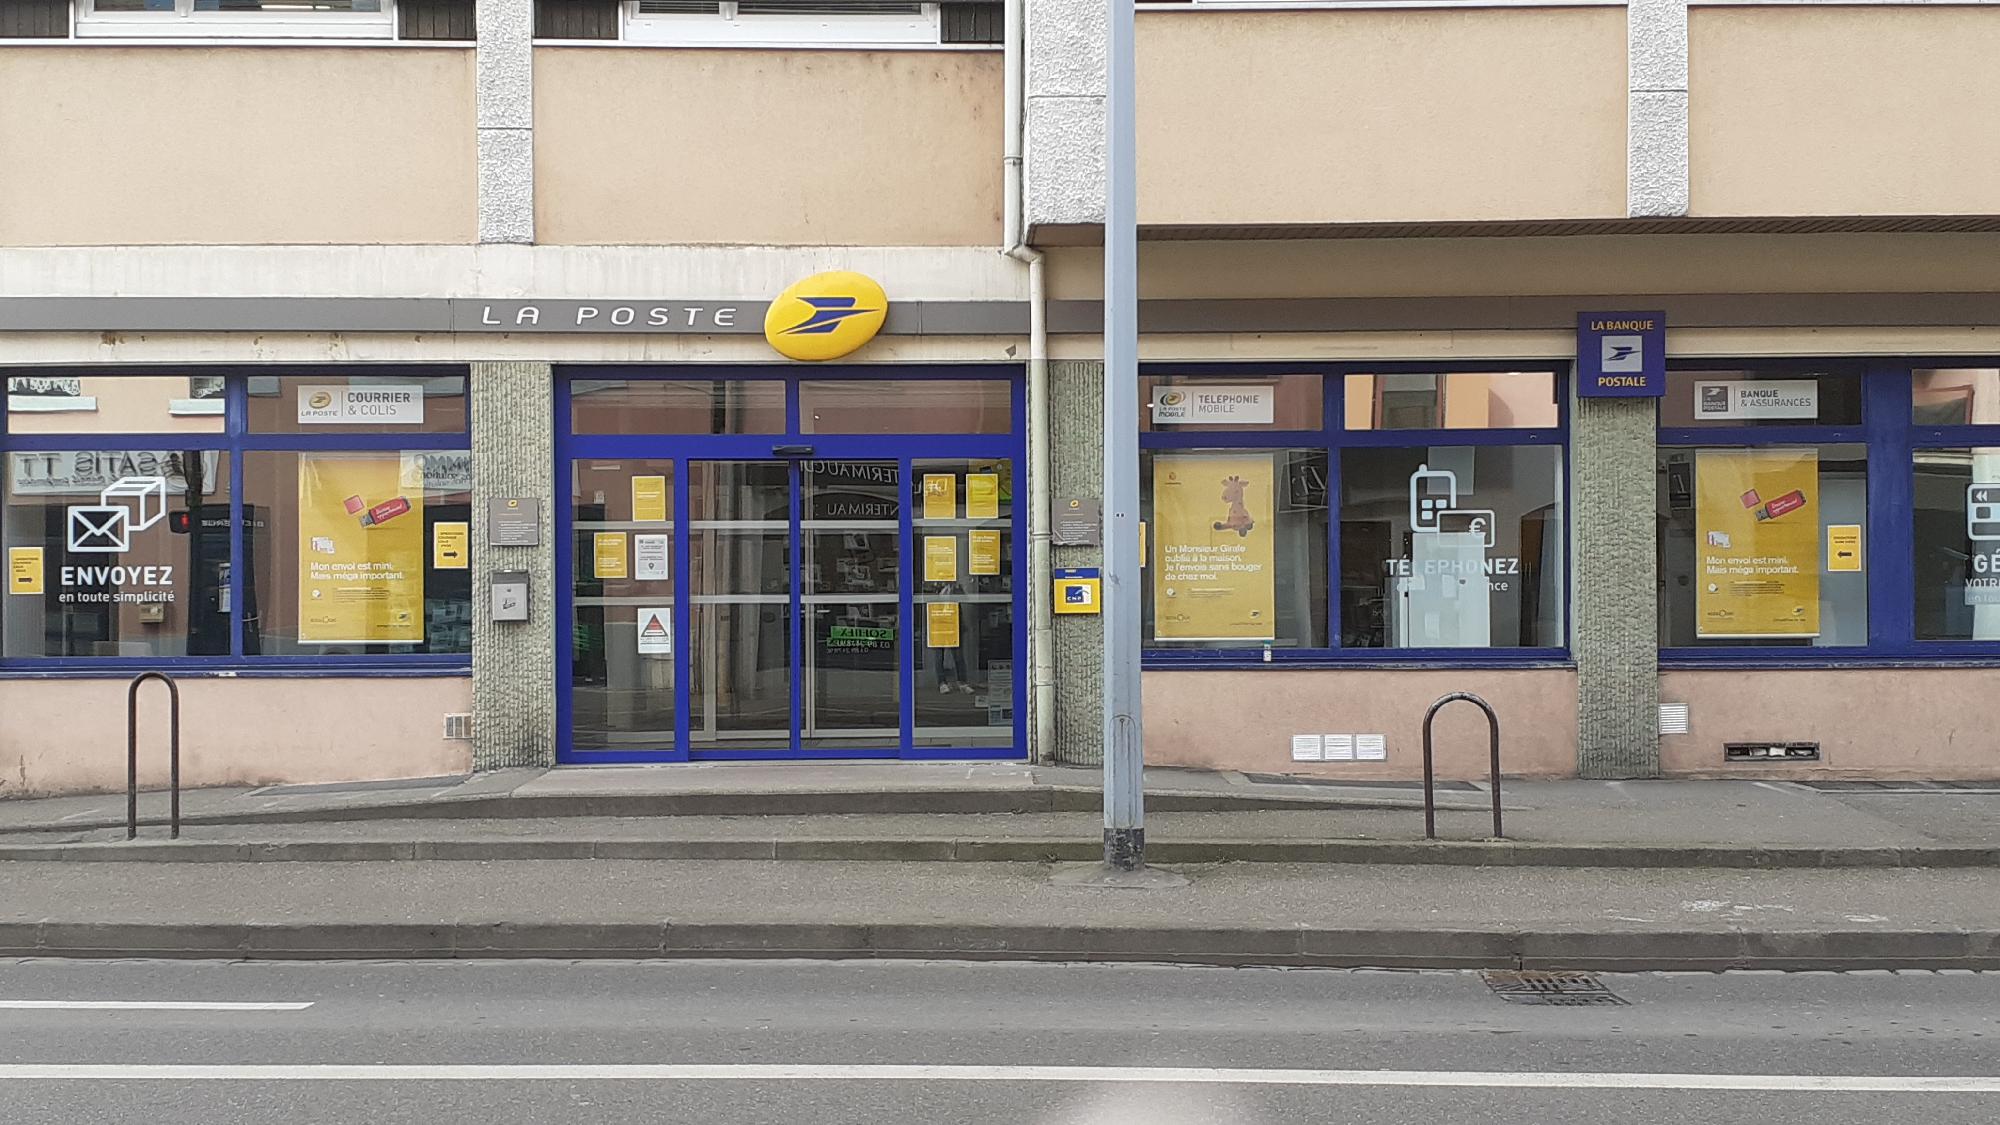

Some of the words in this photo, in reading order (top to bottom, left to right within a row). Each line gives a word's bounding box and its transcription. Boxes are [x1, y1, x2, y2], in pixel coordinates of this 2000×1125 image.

[482, 306, 540, 325] LA
[576, 307, 737, 326] POSTE
[1591, 321, 1604, 331] LA
[1606, 320, 1654, 332] BANQUE
[1598, 376, 1646, 387] POSTALE
[347, 392, 411, 403] COURRIER
[1740, 390, 1779, 398] BANQUE
[1740, 399, 1748, 407] &
[1750, 398, 1811, 407] ASSURANCES
[348, 405, 357, 415] &
[361, 405, 396, 415] COLIS
[1198, 405, 1235, 413] MOBILE
[1179, 545, 1218, 553] Monsieur
[1706, 556, 1726, 564] Mon
[1727, 556, 1751, 564] envoi
[357, 563, 372, 571] est
[1231, 563, 1262, 572] bouger
[1706, 566, 1727, 574] Mais
[1755, 566, 1799, 575] important.
[61, 566, 173, 586] ENVOYEZ
[360, 571, 404, 582] important.
[59, 593, 76, 602] en
[77, 591, 110, 602] toute
[112, 590, 175, 605] simplicité
